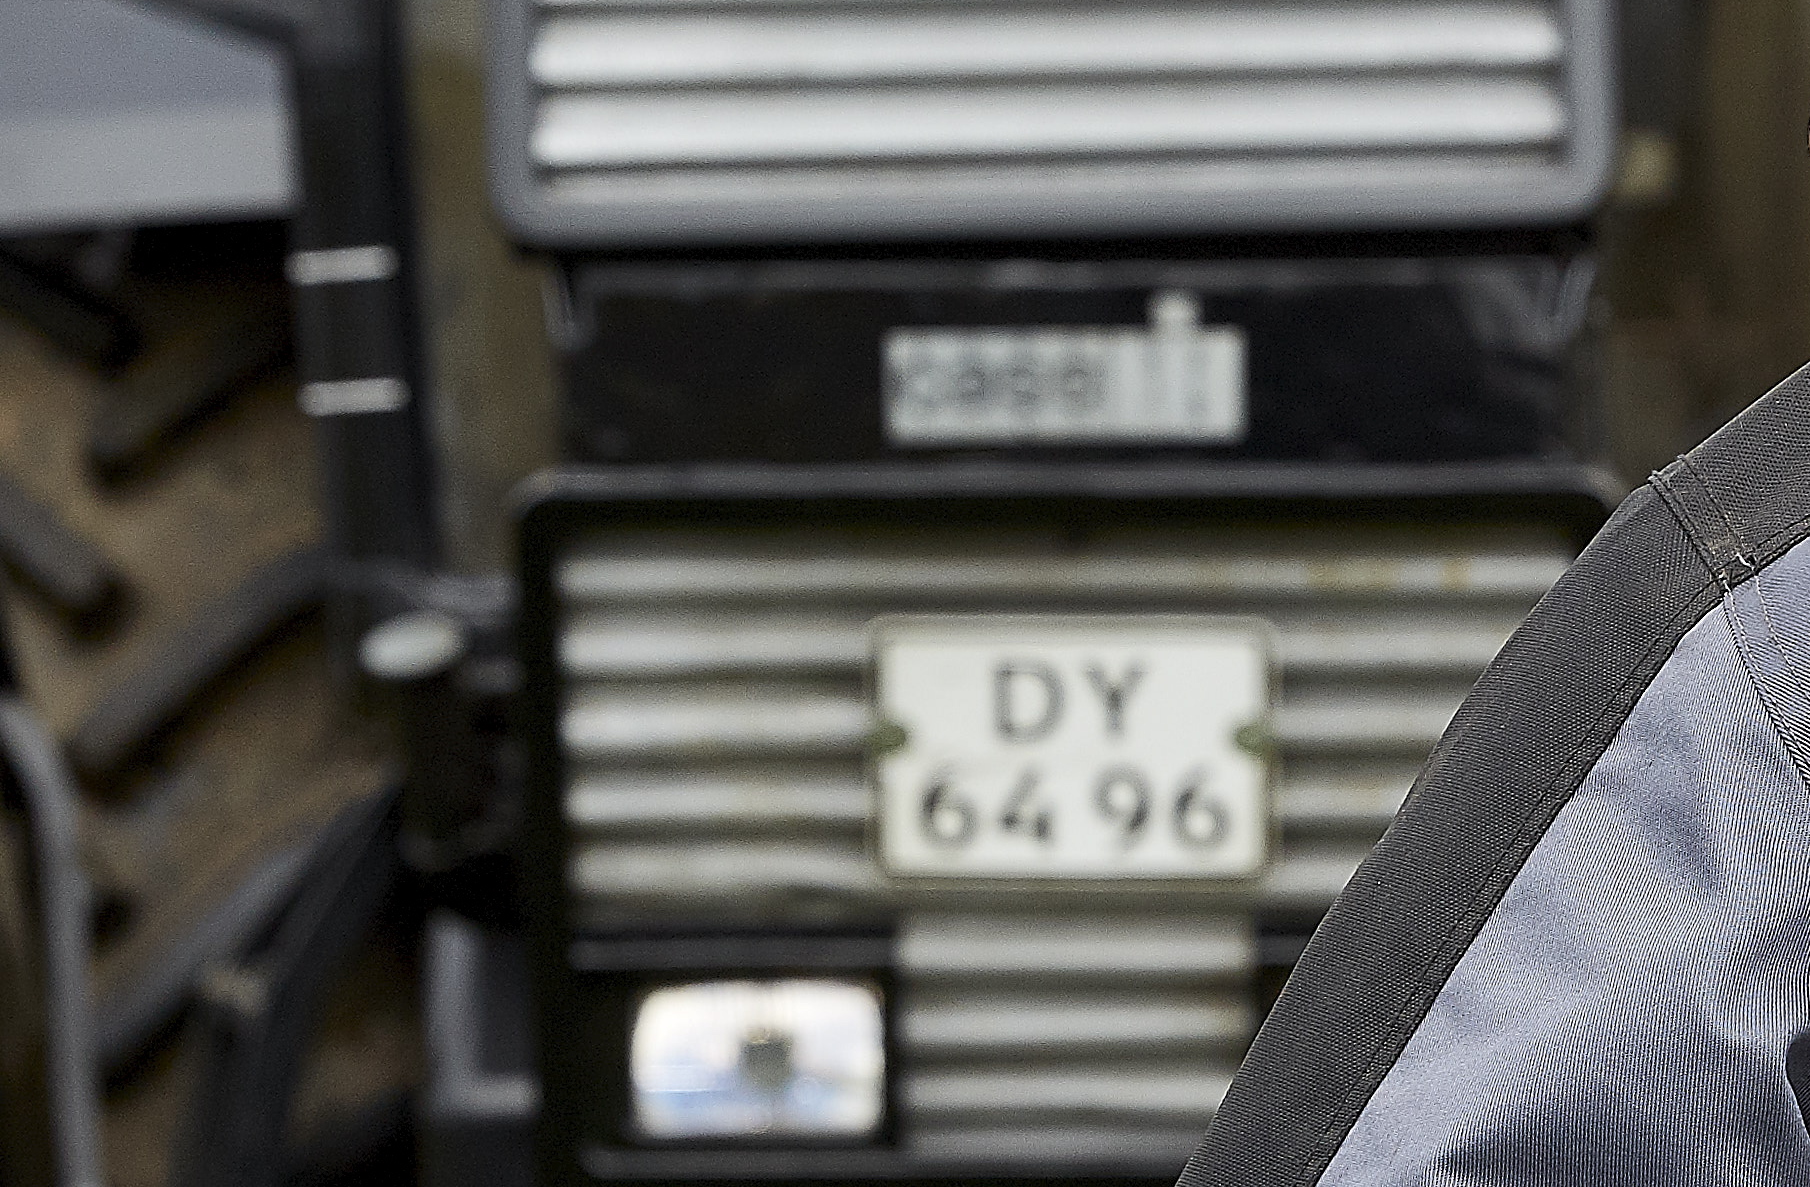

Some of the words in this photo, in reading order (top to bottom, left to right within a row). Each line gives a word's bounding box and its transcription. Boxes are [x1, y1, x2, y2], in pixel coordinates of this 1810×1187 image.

[990, 658, 1152, 744] DY
[917, 764, 1055, 850] 64
[1094, 764, 1232, 852] 96
